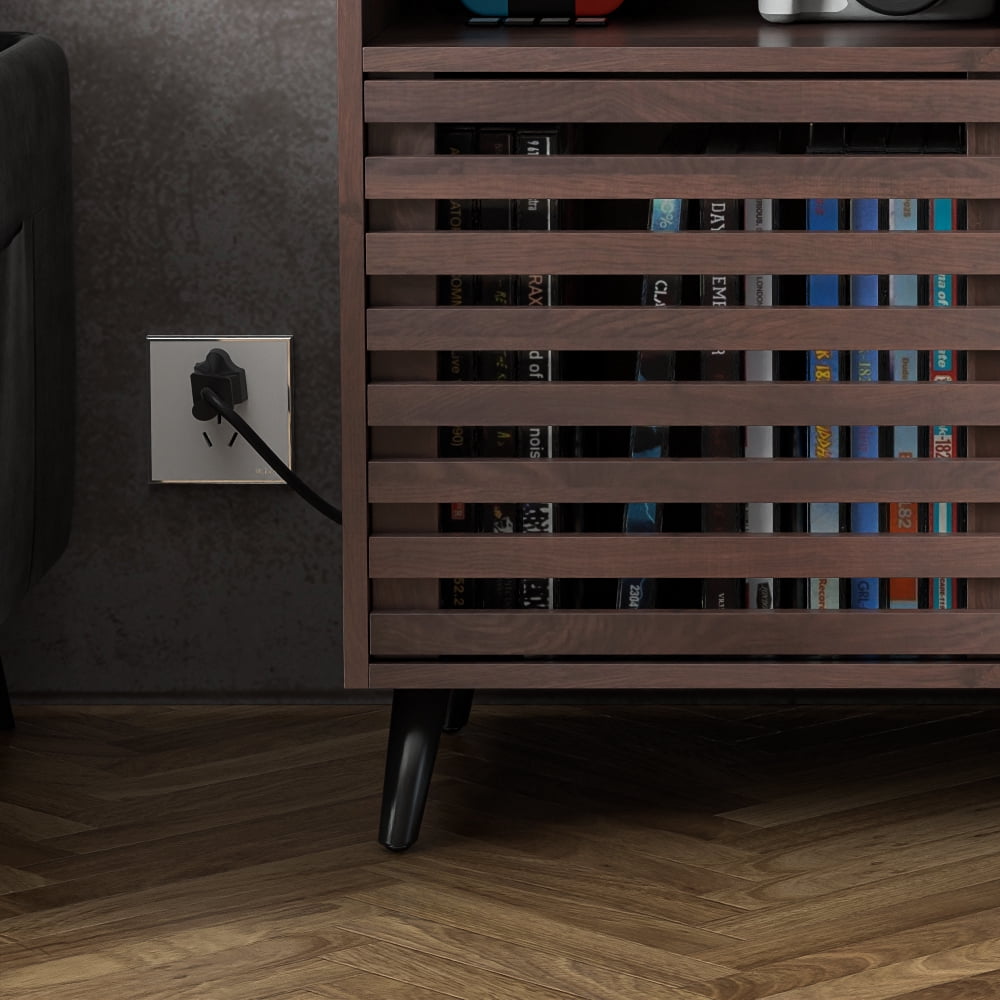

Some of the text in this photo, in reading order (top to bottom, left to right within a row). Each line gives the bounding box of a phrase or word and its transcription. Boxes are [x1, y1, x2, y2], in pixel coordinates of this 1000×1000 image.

[938, 291, 949, 306] of
[529, 363, 545, 379] of
[815, 365, 831, 382] 18
